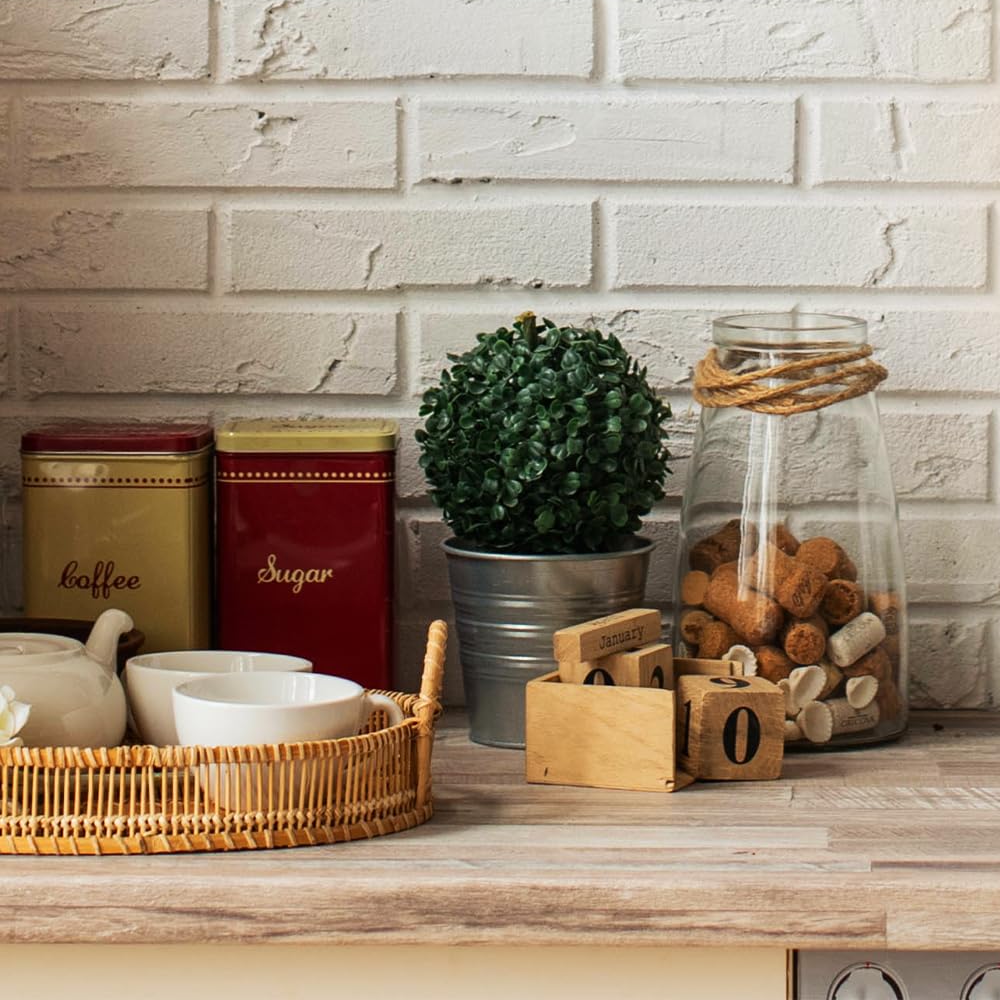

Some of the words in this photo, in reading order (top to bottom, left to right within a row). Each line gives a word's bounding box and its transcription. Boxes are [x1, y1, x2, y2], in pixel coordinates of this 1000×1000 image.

[57, 560, 141, 600] Coffee
[257, 554, 334, 594] Sugar
[599, 625, 645, 650] January
[722, 706, 761, 765] 0
